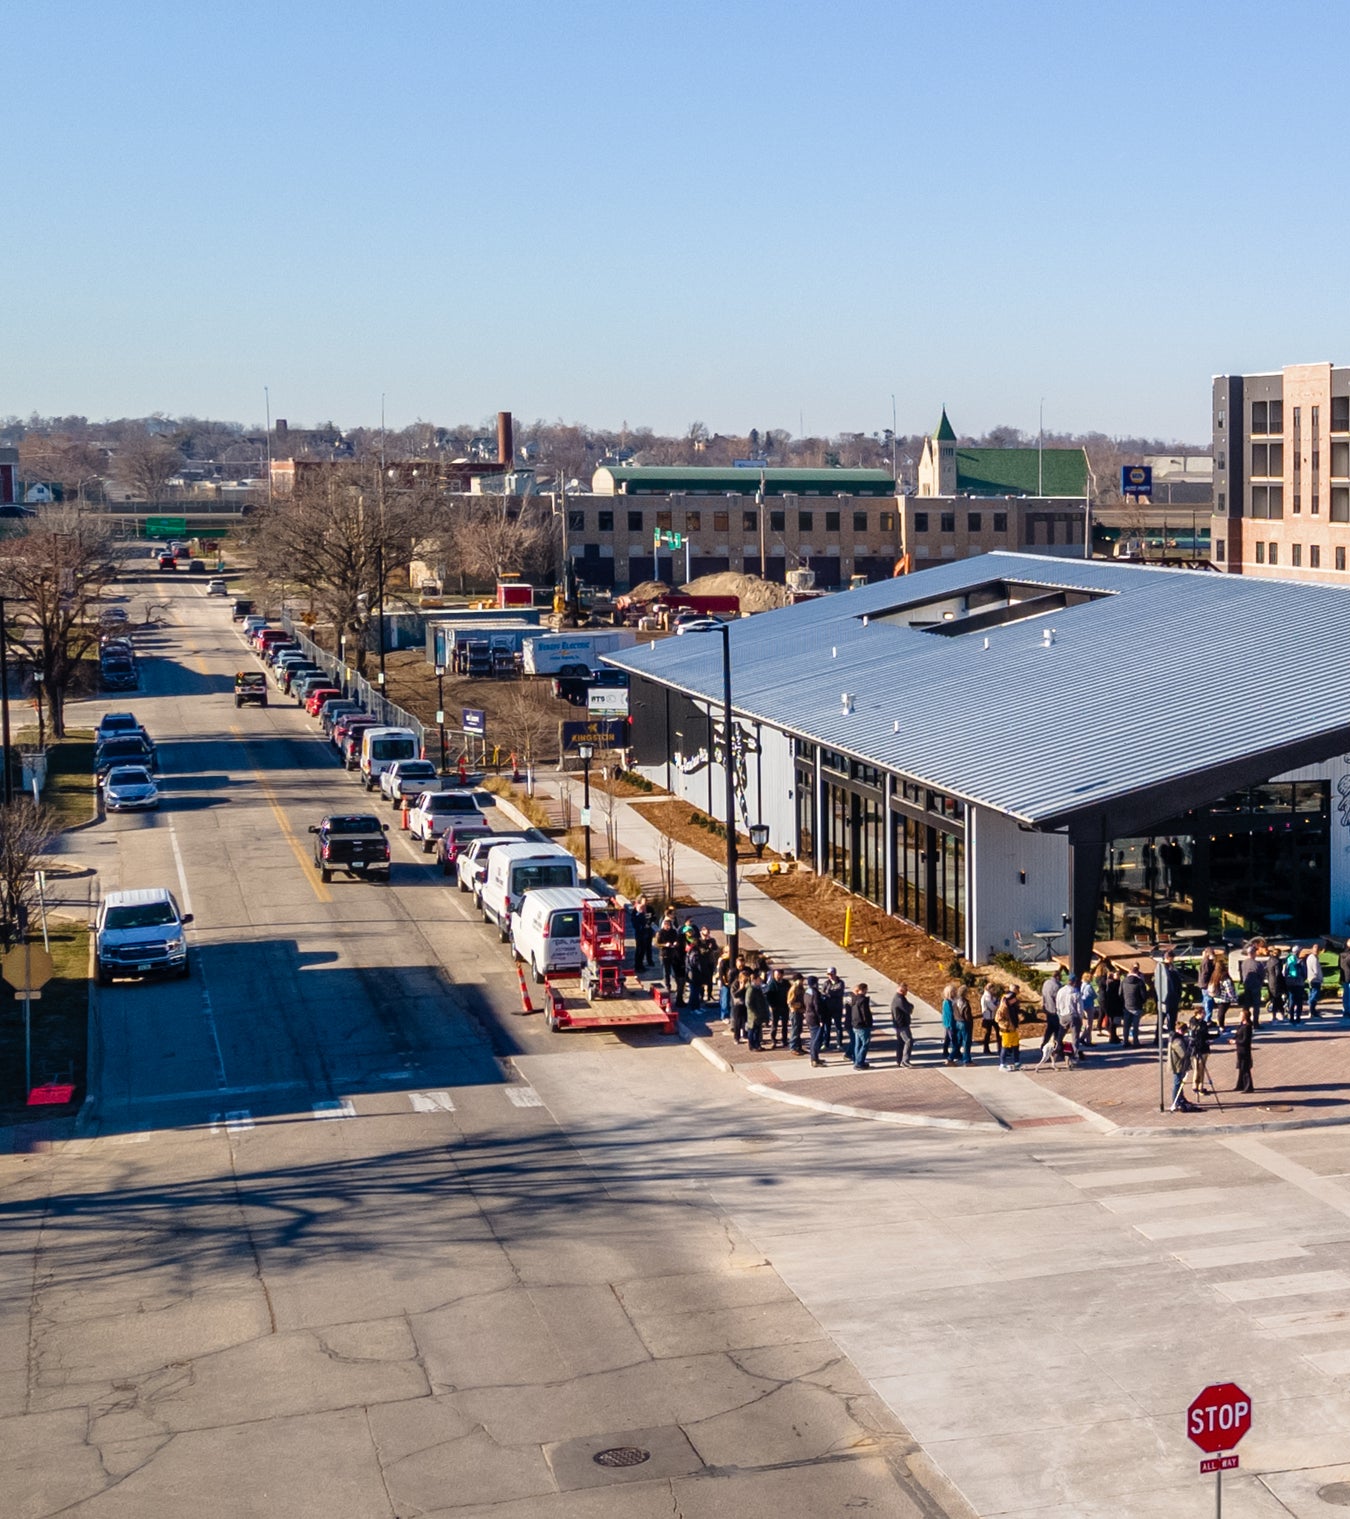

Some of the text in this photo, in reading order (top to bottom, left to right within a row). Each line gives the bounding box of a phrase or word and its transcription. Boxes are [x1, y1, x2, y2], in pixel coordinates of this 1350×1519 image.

[571, 733, 615, 743] KINGSTON
[1190, 1401, 1249, 1435] STOP
[1202, 1458, 1237, 1471] ALL WAY
